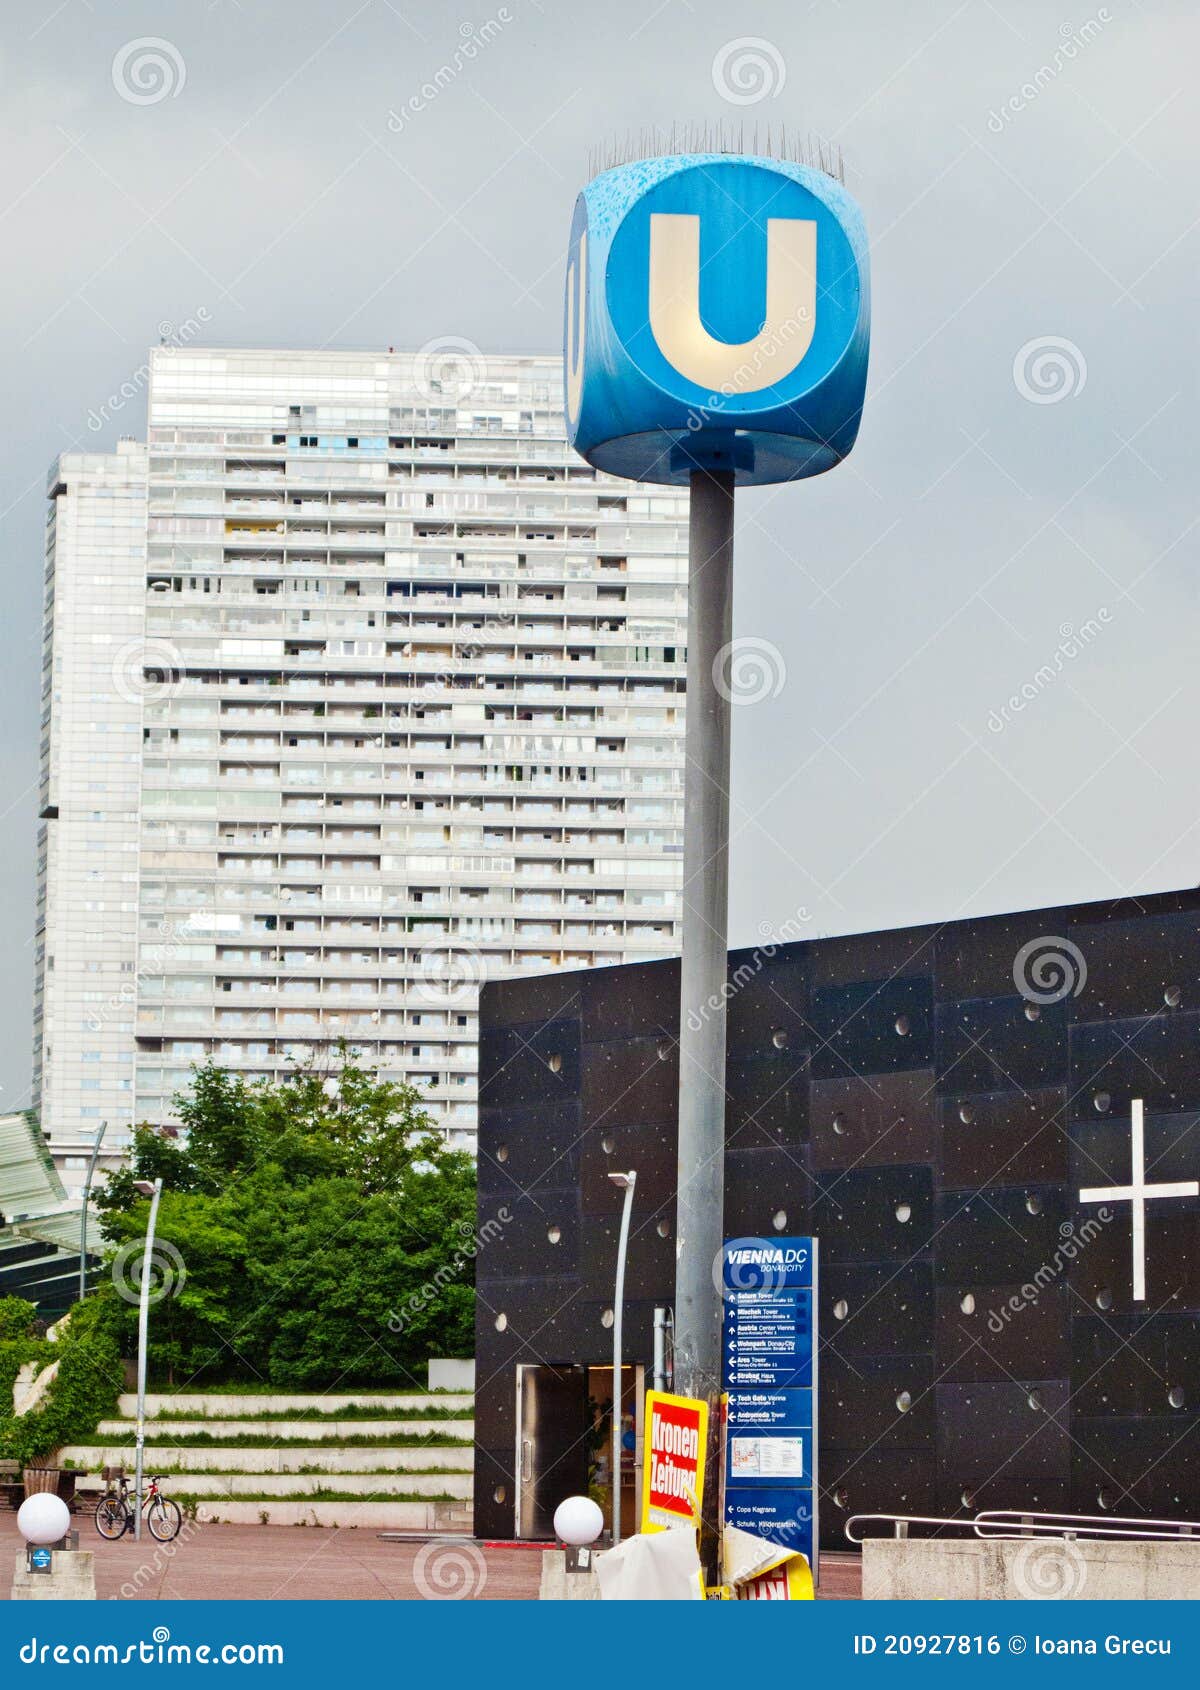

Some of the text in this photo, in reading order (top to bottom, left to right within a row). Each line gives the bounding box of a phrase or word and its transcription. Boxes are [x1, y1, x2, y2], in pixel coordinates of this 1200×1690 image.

[649, 213, 817, 394] U
[737, 1340, 766, 1348] Wohnpark
[651, 1411, 699, 1460] Kronen
[650, 1453, 697, 1506] Zeitung
[736, 1520, 797, 1529] Schule, Kindergarten
[752, 1506, 776, 1514] Kagrana
